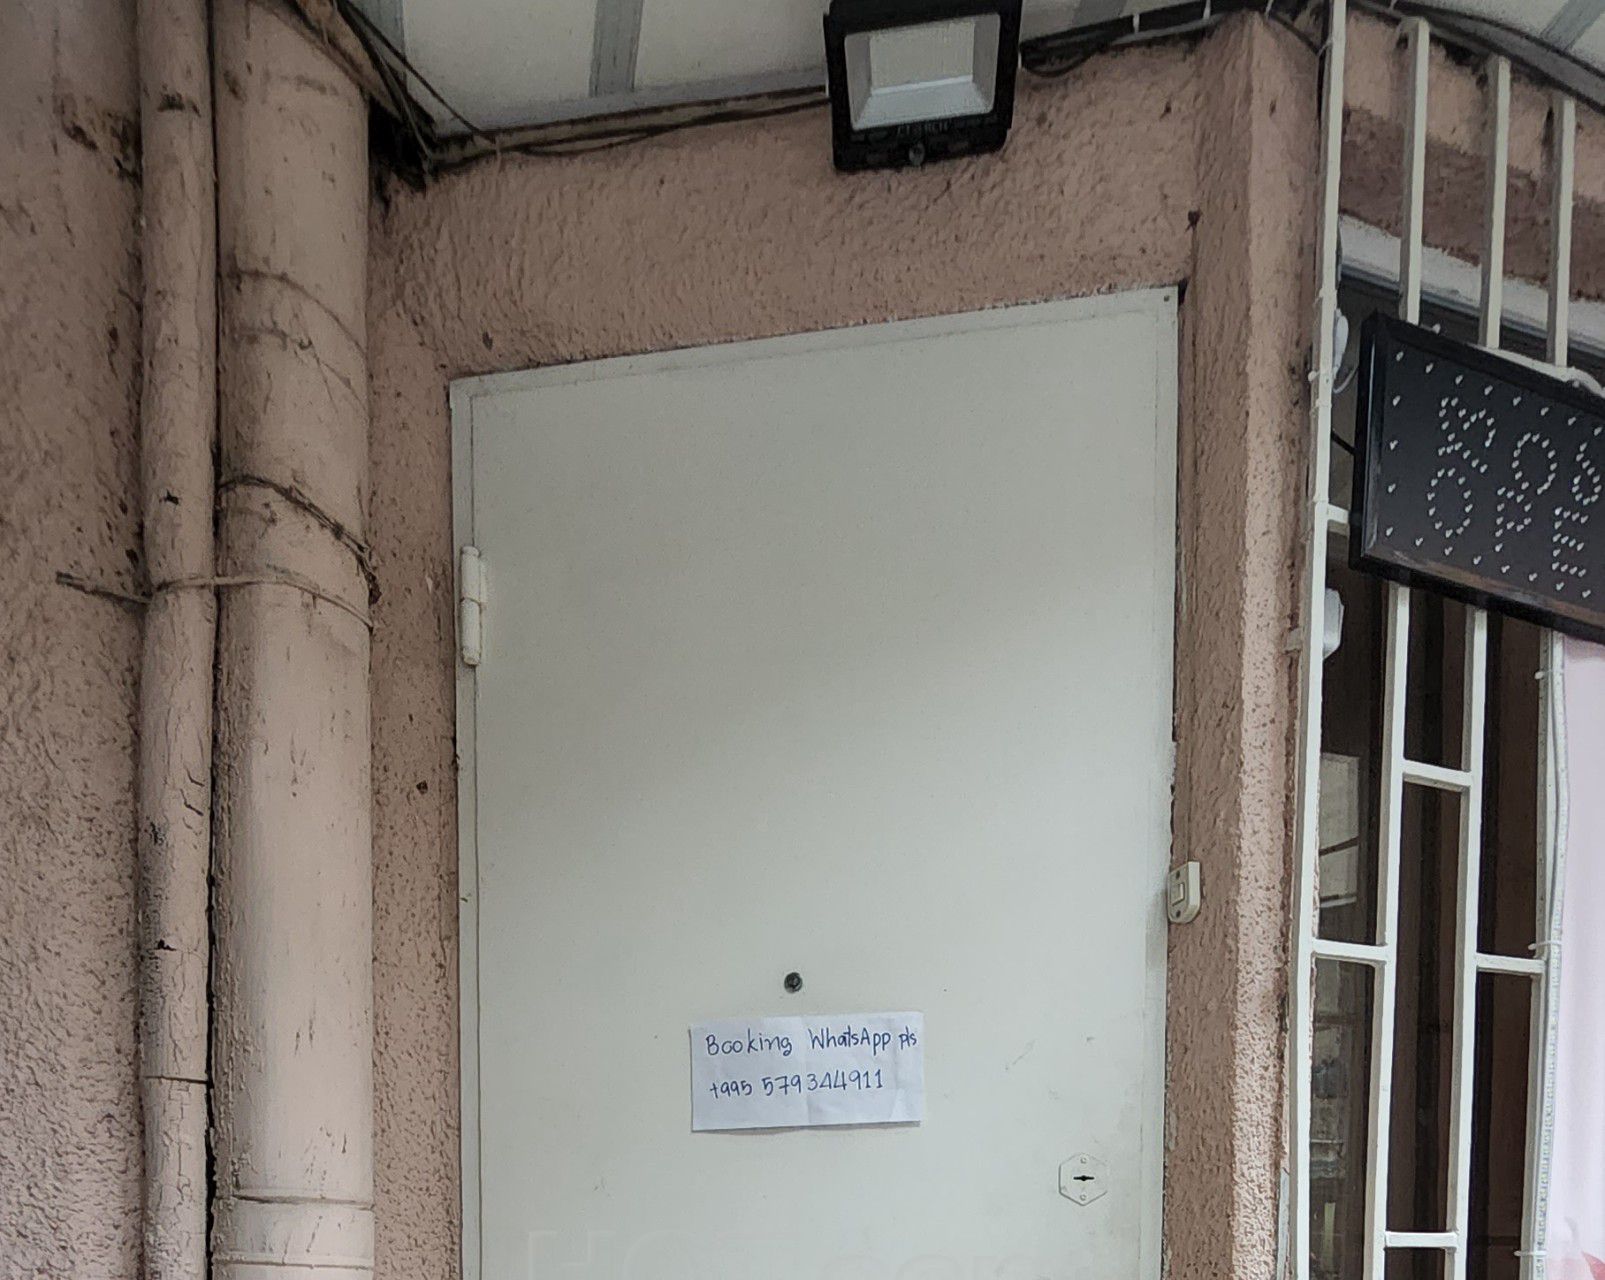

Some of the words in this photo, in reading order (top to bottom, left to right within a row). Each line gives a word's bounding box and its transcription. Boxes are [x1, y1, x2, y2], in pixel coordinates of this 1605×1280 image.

[1427, 467, 1589, 577] OPE
[706, 1028, 793, 1056] Booking
[808, 1025, 891, 1056] WhatsApp
[709, 1080, 752, 1098] +995
